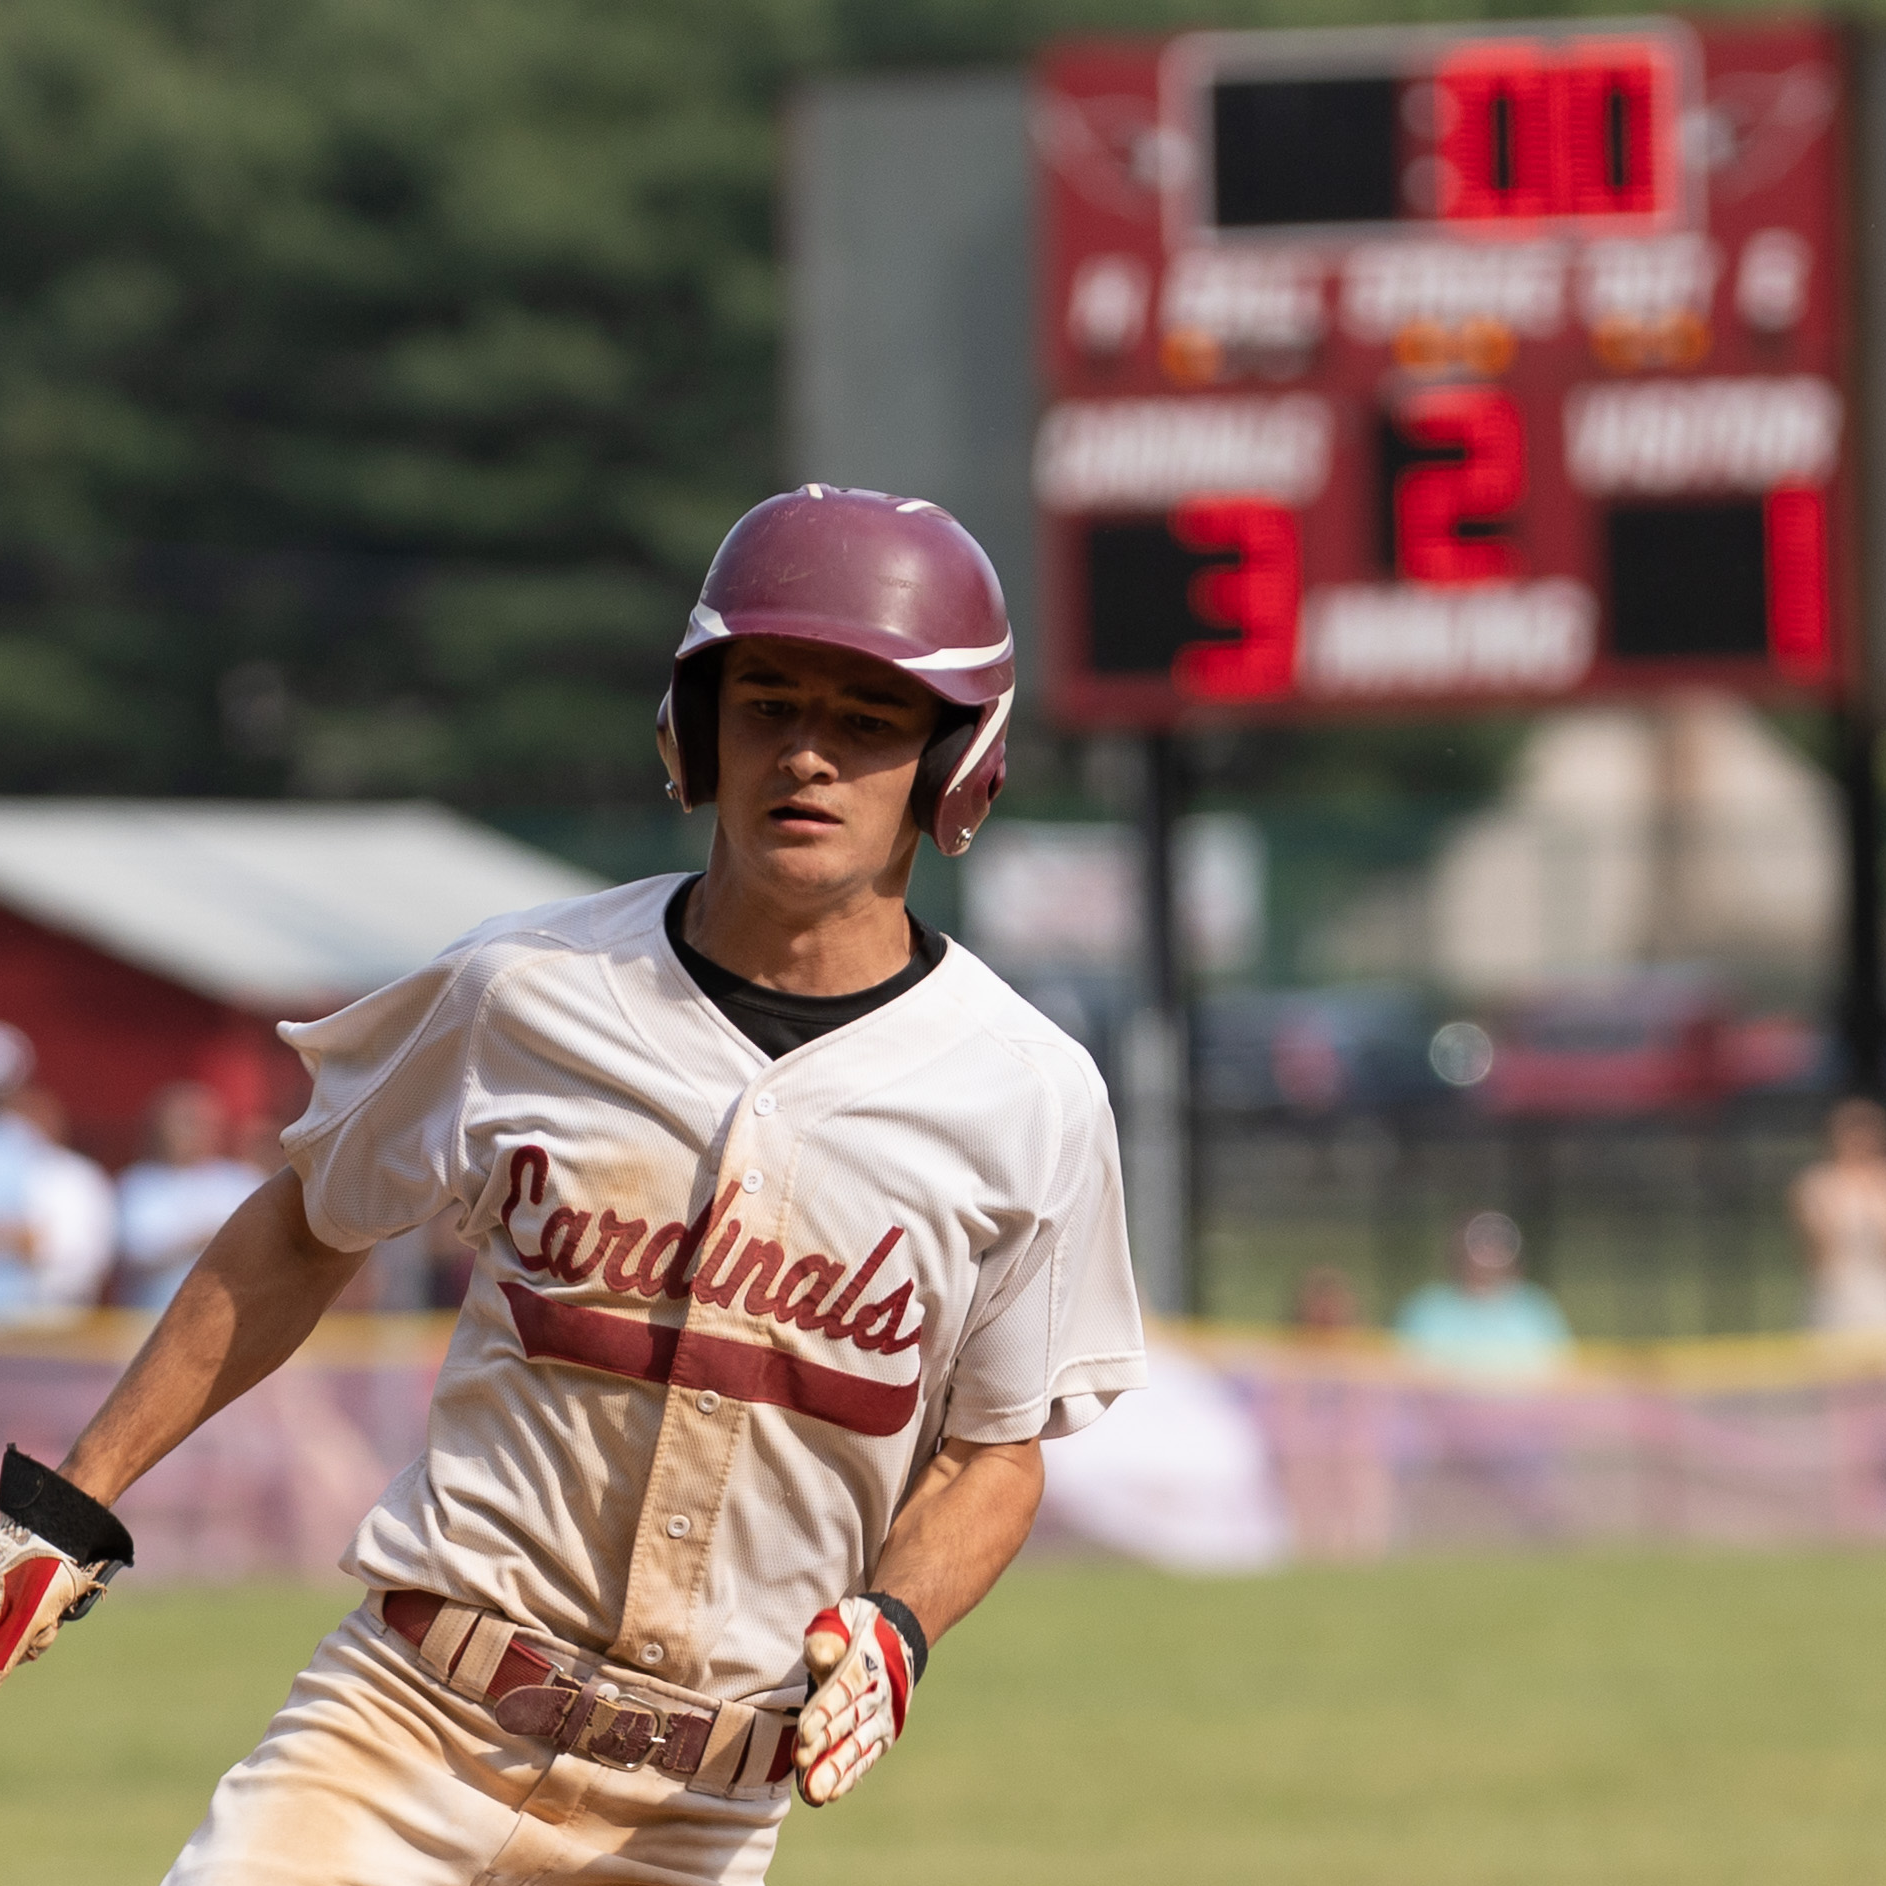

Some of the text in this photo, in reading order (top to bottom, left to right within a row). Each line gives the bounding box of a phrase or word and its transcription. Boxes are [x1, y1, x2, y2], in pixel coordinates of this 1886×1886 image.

[1397, 390, 1525, 586] 2
[1173, 496, 1301, 702] 3
[501, 1144, 923, 1354] Cardinals
